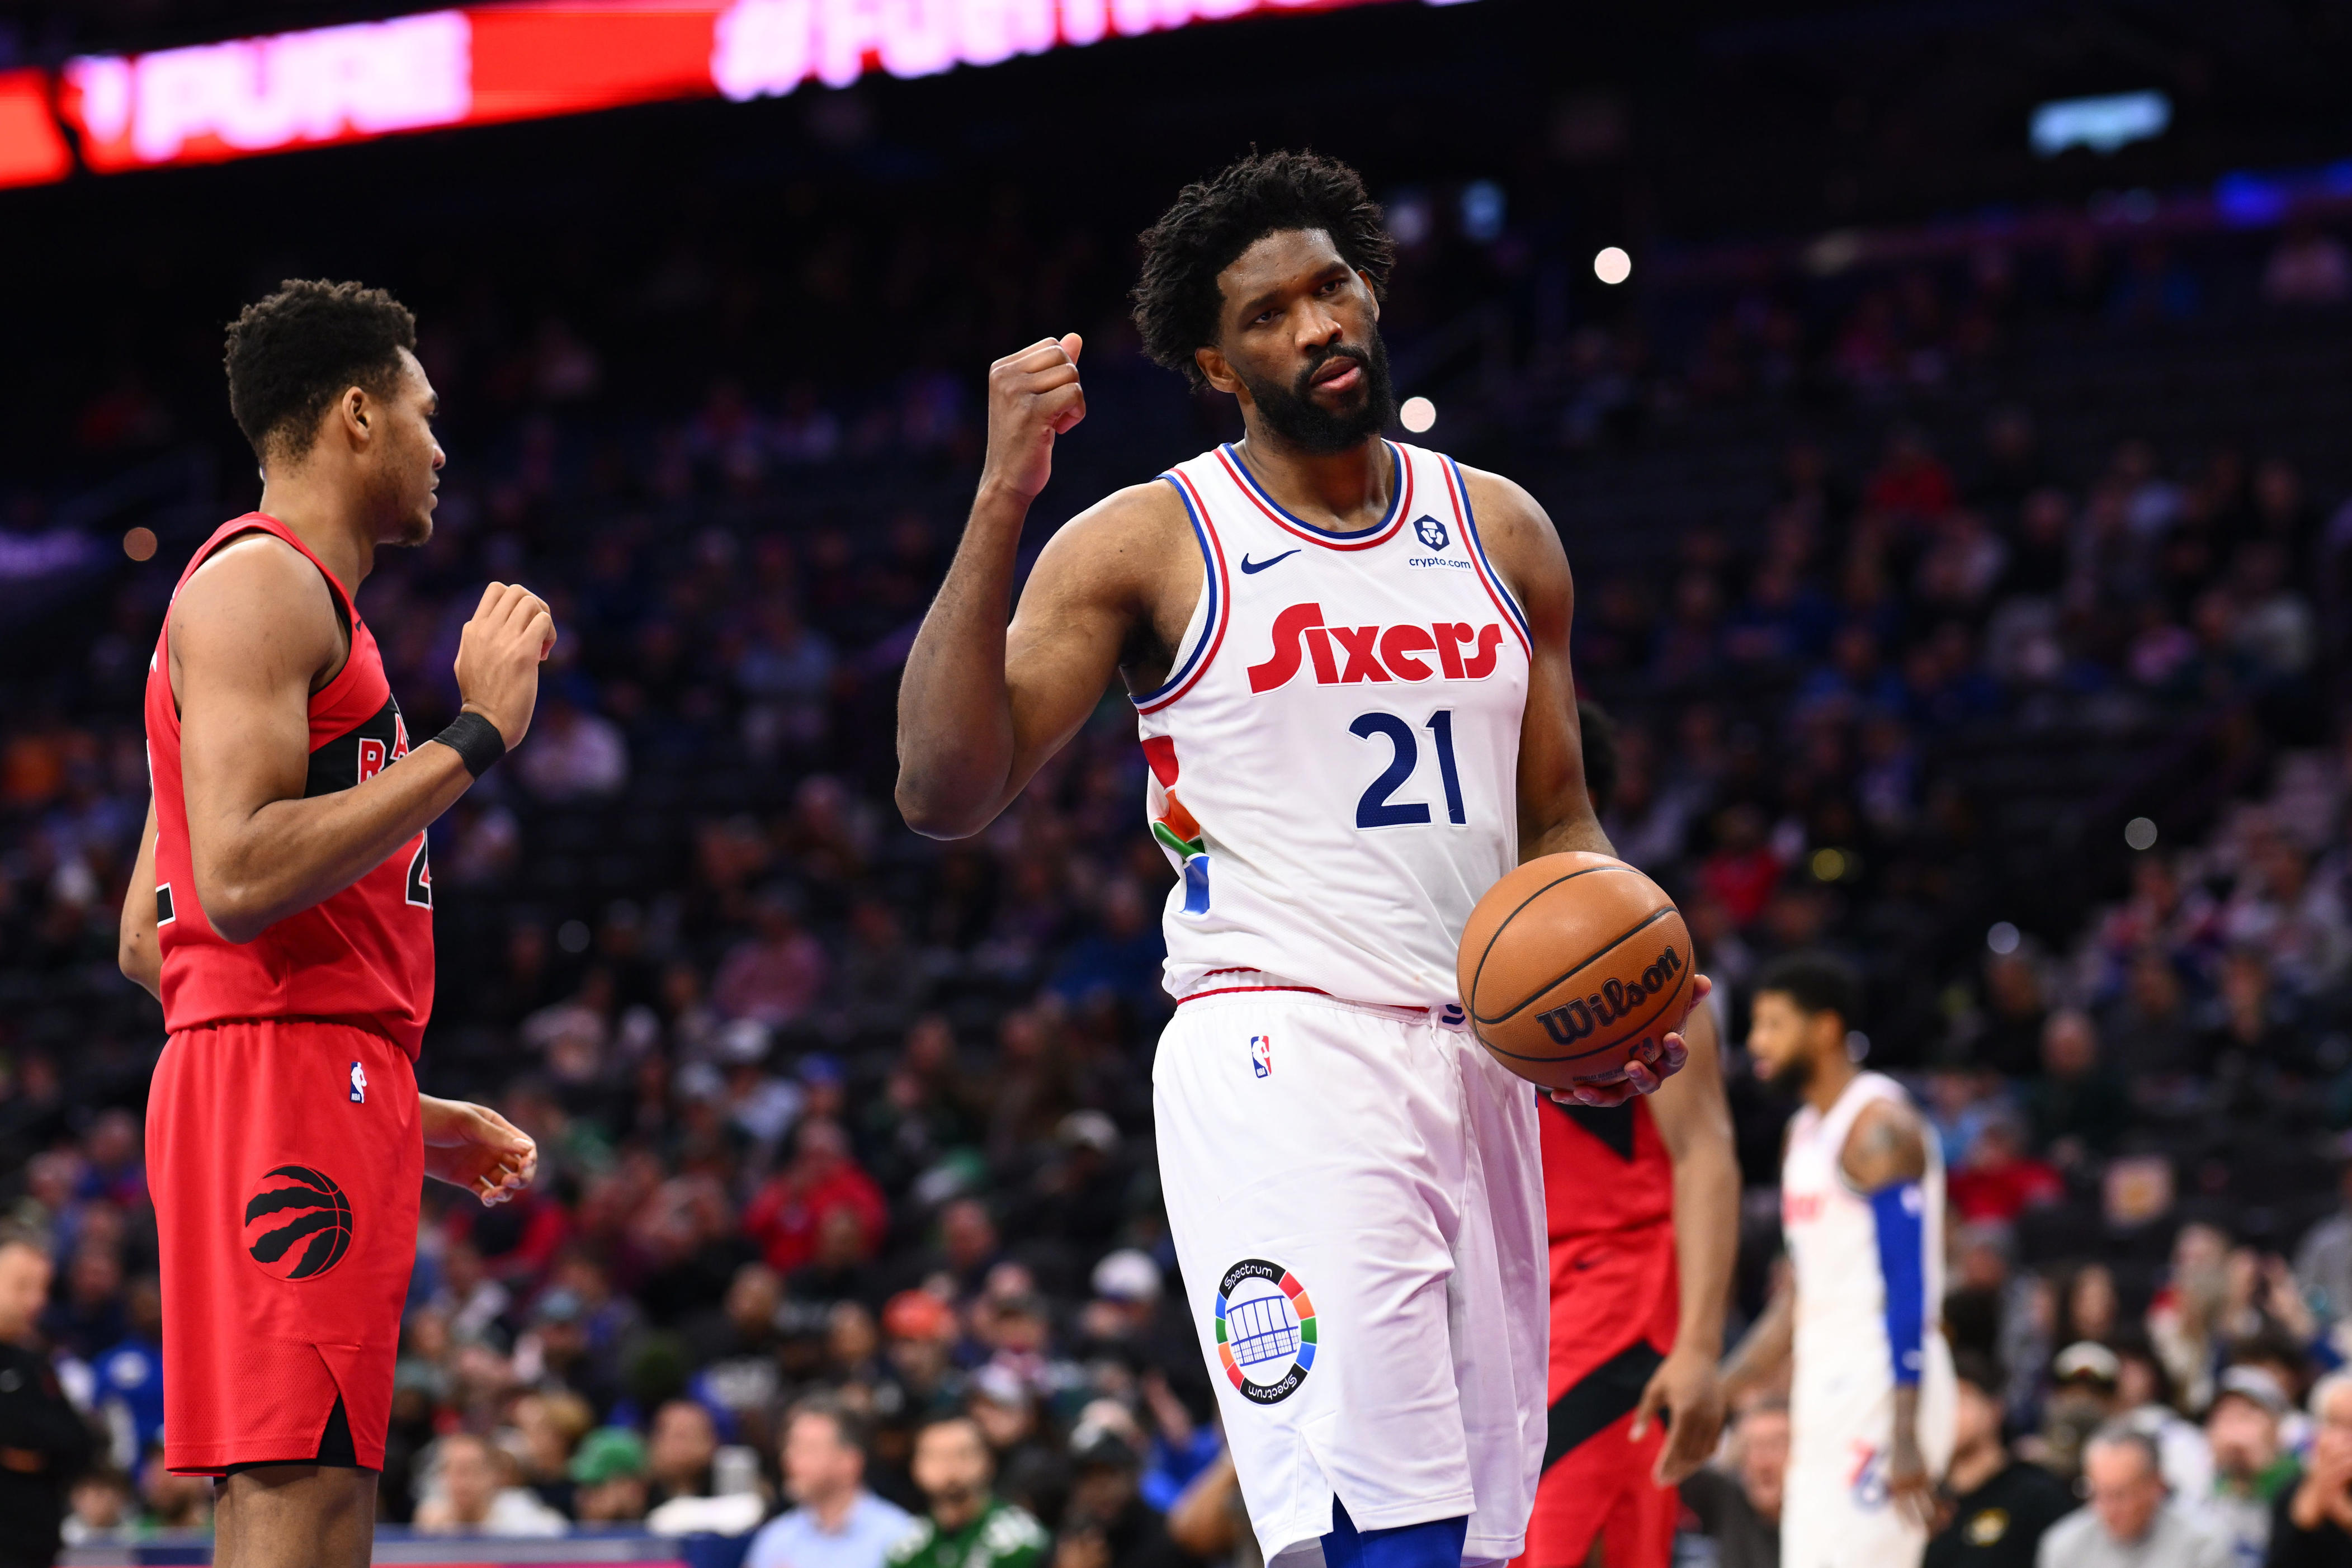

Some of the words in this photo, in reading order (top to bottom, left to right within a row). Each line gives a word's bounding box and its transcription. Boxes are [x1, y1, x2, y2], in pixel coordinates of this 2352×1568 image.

[1409, 556, 1471, 569] crypto.com
[1246, 601, 1505, 695] Sixers
[1347, 709, 1468, 830] 21
[1535, 946, 1681, 1045] Wilson
[1257, 1068, 1266, 1076] NBA
[351, 1093, 361, 1101] NBA
[1224, 1263, 1273, 1291] Spectrum
[1248, 1373, 1298, 1401] Spectrum
